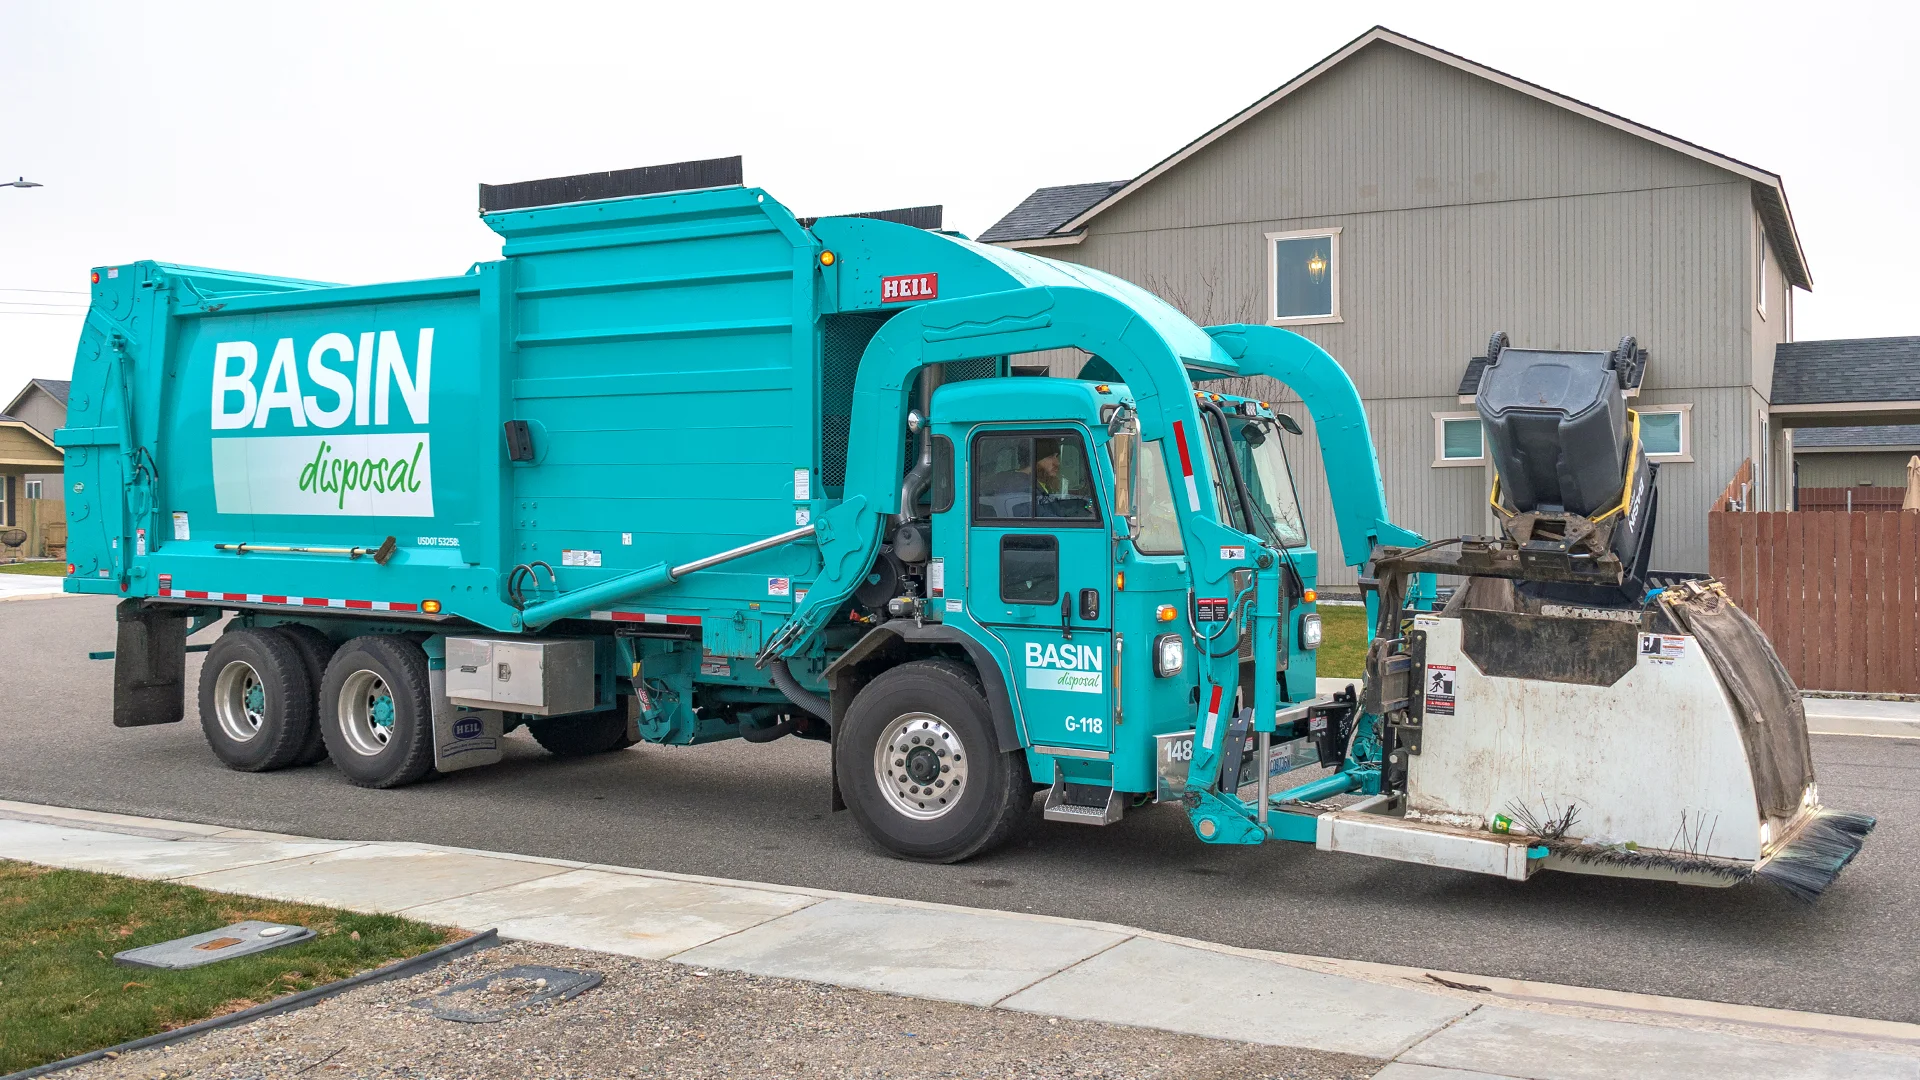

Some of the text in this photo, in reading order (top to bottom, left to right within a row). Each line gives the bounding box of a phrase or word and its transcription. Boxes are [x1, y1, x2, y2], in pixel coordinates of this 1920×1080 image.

[884, 278, 932, 298] HEIL
[211, 328, 435, 430] BASIN
[299, 440, 424, 510] disposal
[417, 536, 437, 546] USDOT
[1025, 642, 1102, 671] BASIN
[1057, 671, 1101, 690] disposal
[456, 722, 480, 735] HEIL
[1065, 715, 1103, 734] G-118
[1163, 739, 1193, 762] 148
